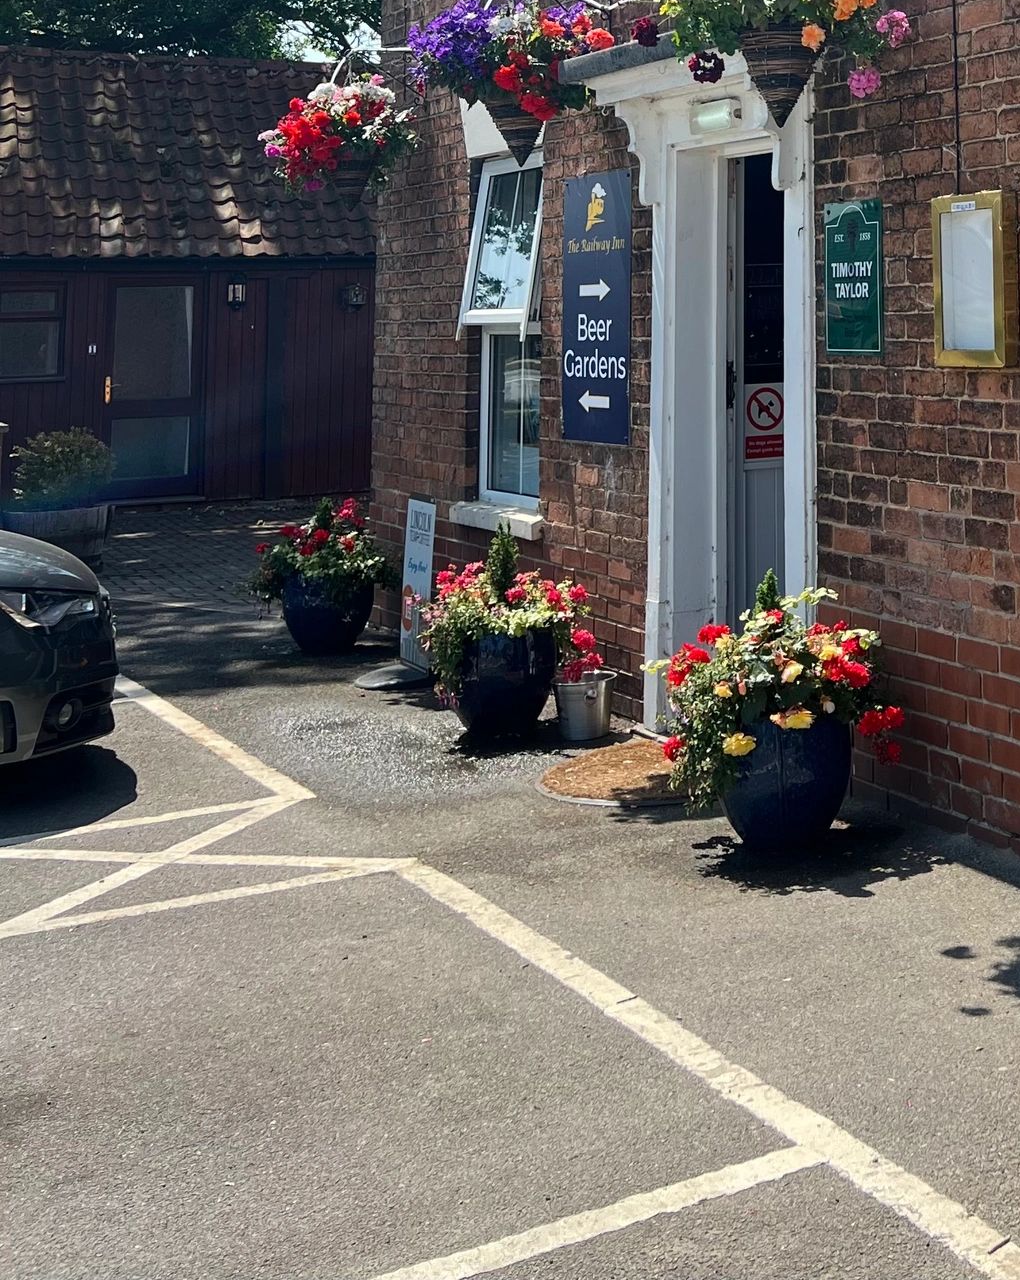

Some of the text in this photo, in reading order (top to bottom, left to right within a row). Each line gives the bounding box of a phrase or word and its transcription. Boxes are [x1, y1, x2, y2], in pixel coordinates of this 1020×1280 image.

[567, 236, 625, 256] The Railway Inn
[831, 261, 873, 278] TIMOTHY
[835, 282, 869, 299] TAYLOR
[577, 313, 613, 342] Beer
[564, 348, 627, 380] Gardens
